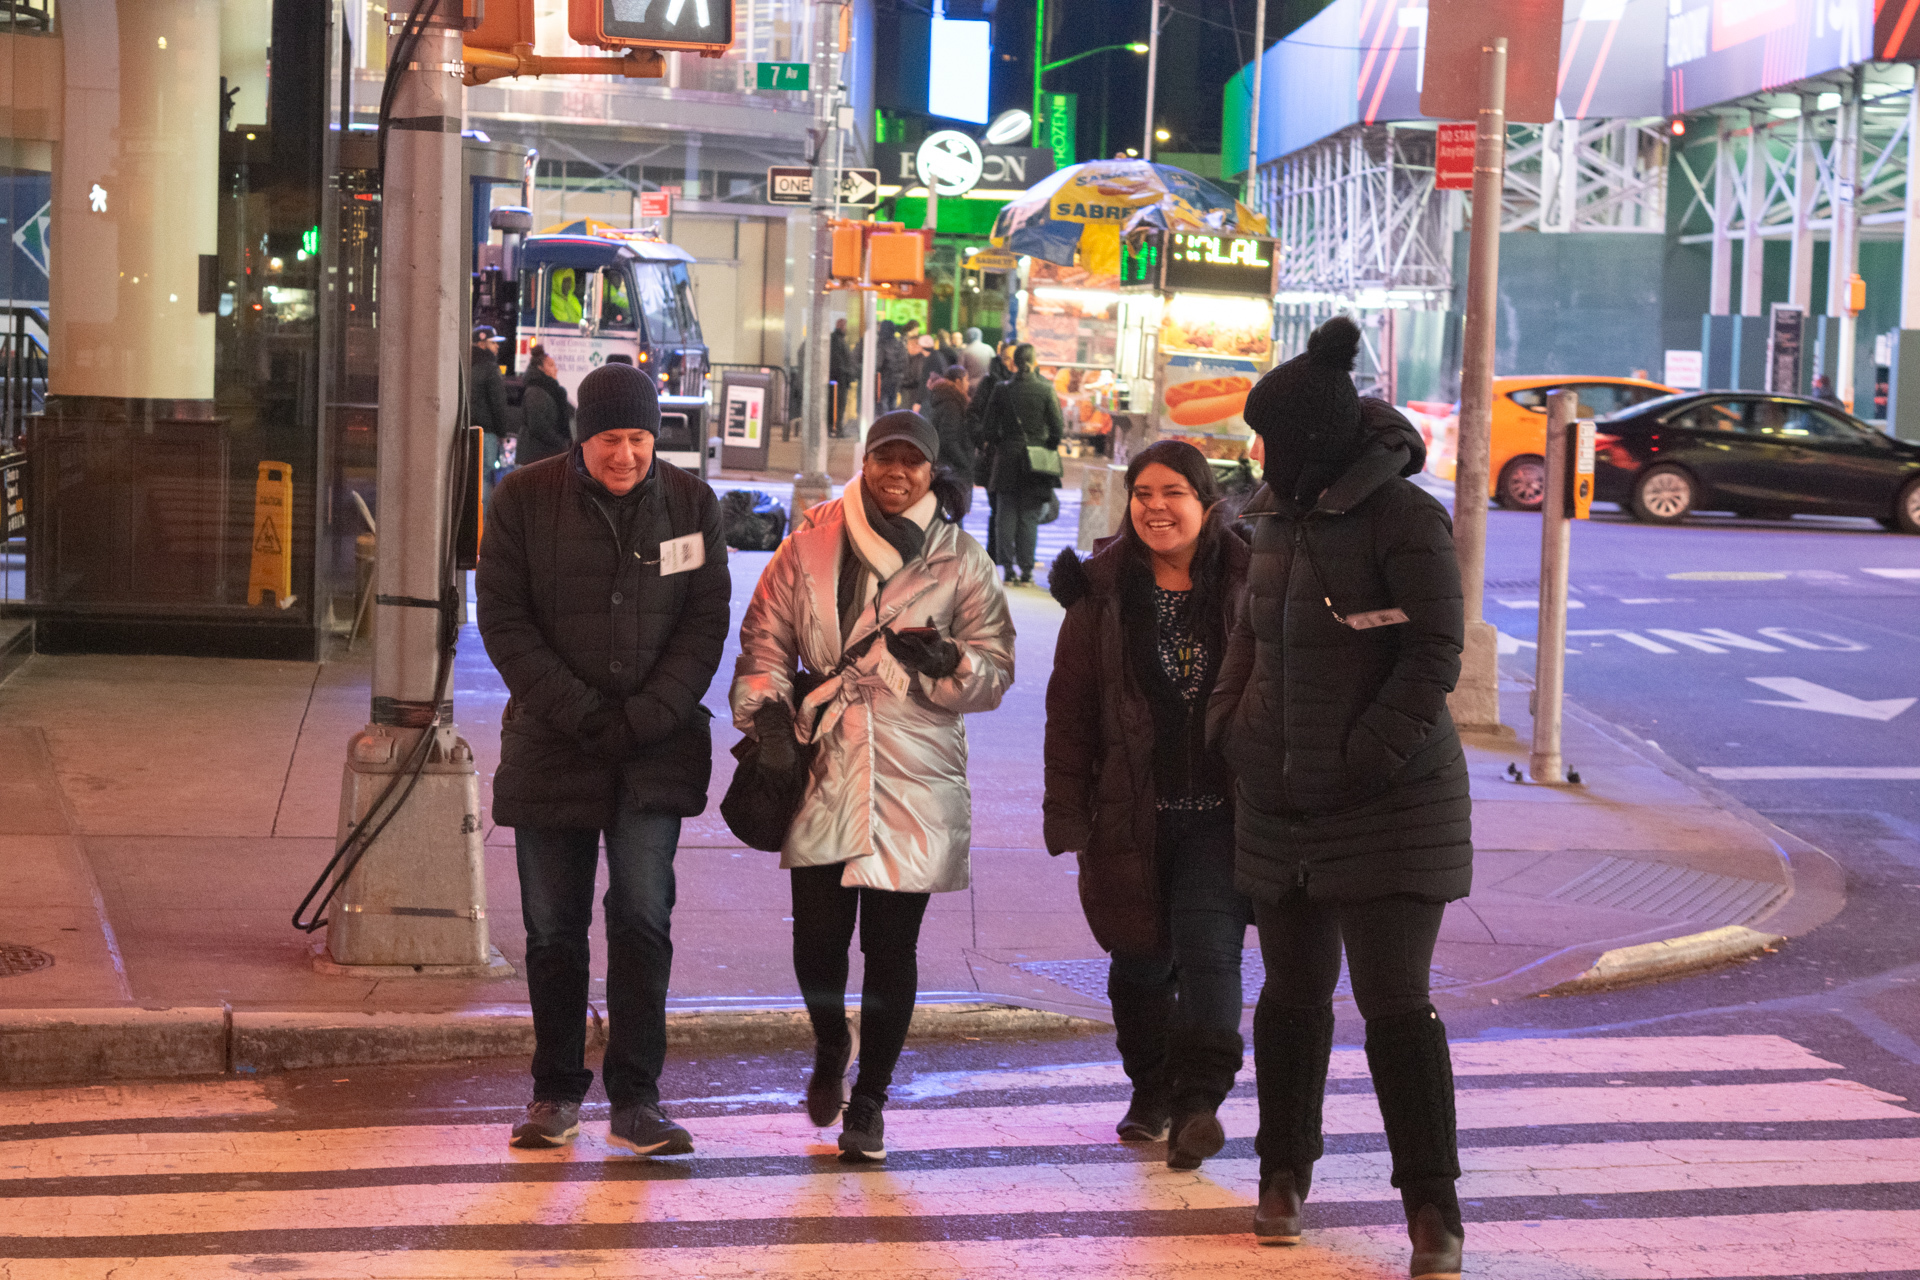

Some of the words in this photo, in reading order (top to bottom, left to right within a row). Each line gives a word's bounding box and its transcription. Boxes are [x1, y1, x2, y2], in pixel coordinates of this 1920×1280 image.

[770, 65, 781, 87] 7
[785, 66, 799, 80] Av
[1441, 129, 1453, 142] NO
[1454, 129, 1476, 143] STAN
[779, 178, 811, 192] ONE
[1056, 202, 1148, 220] SABRE
